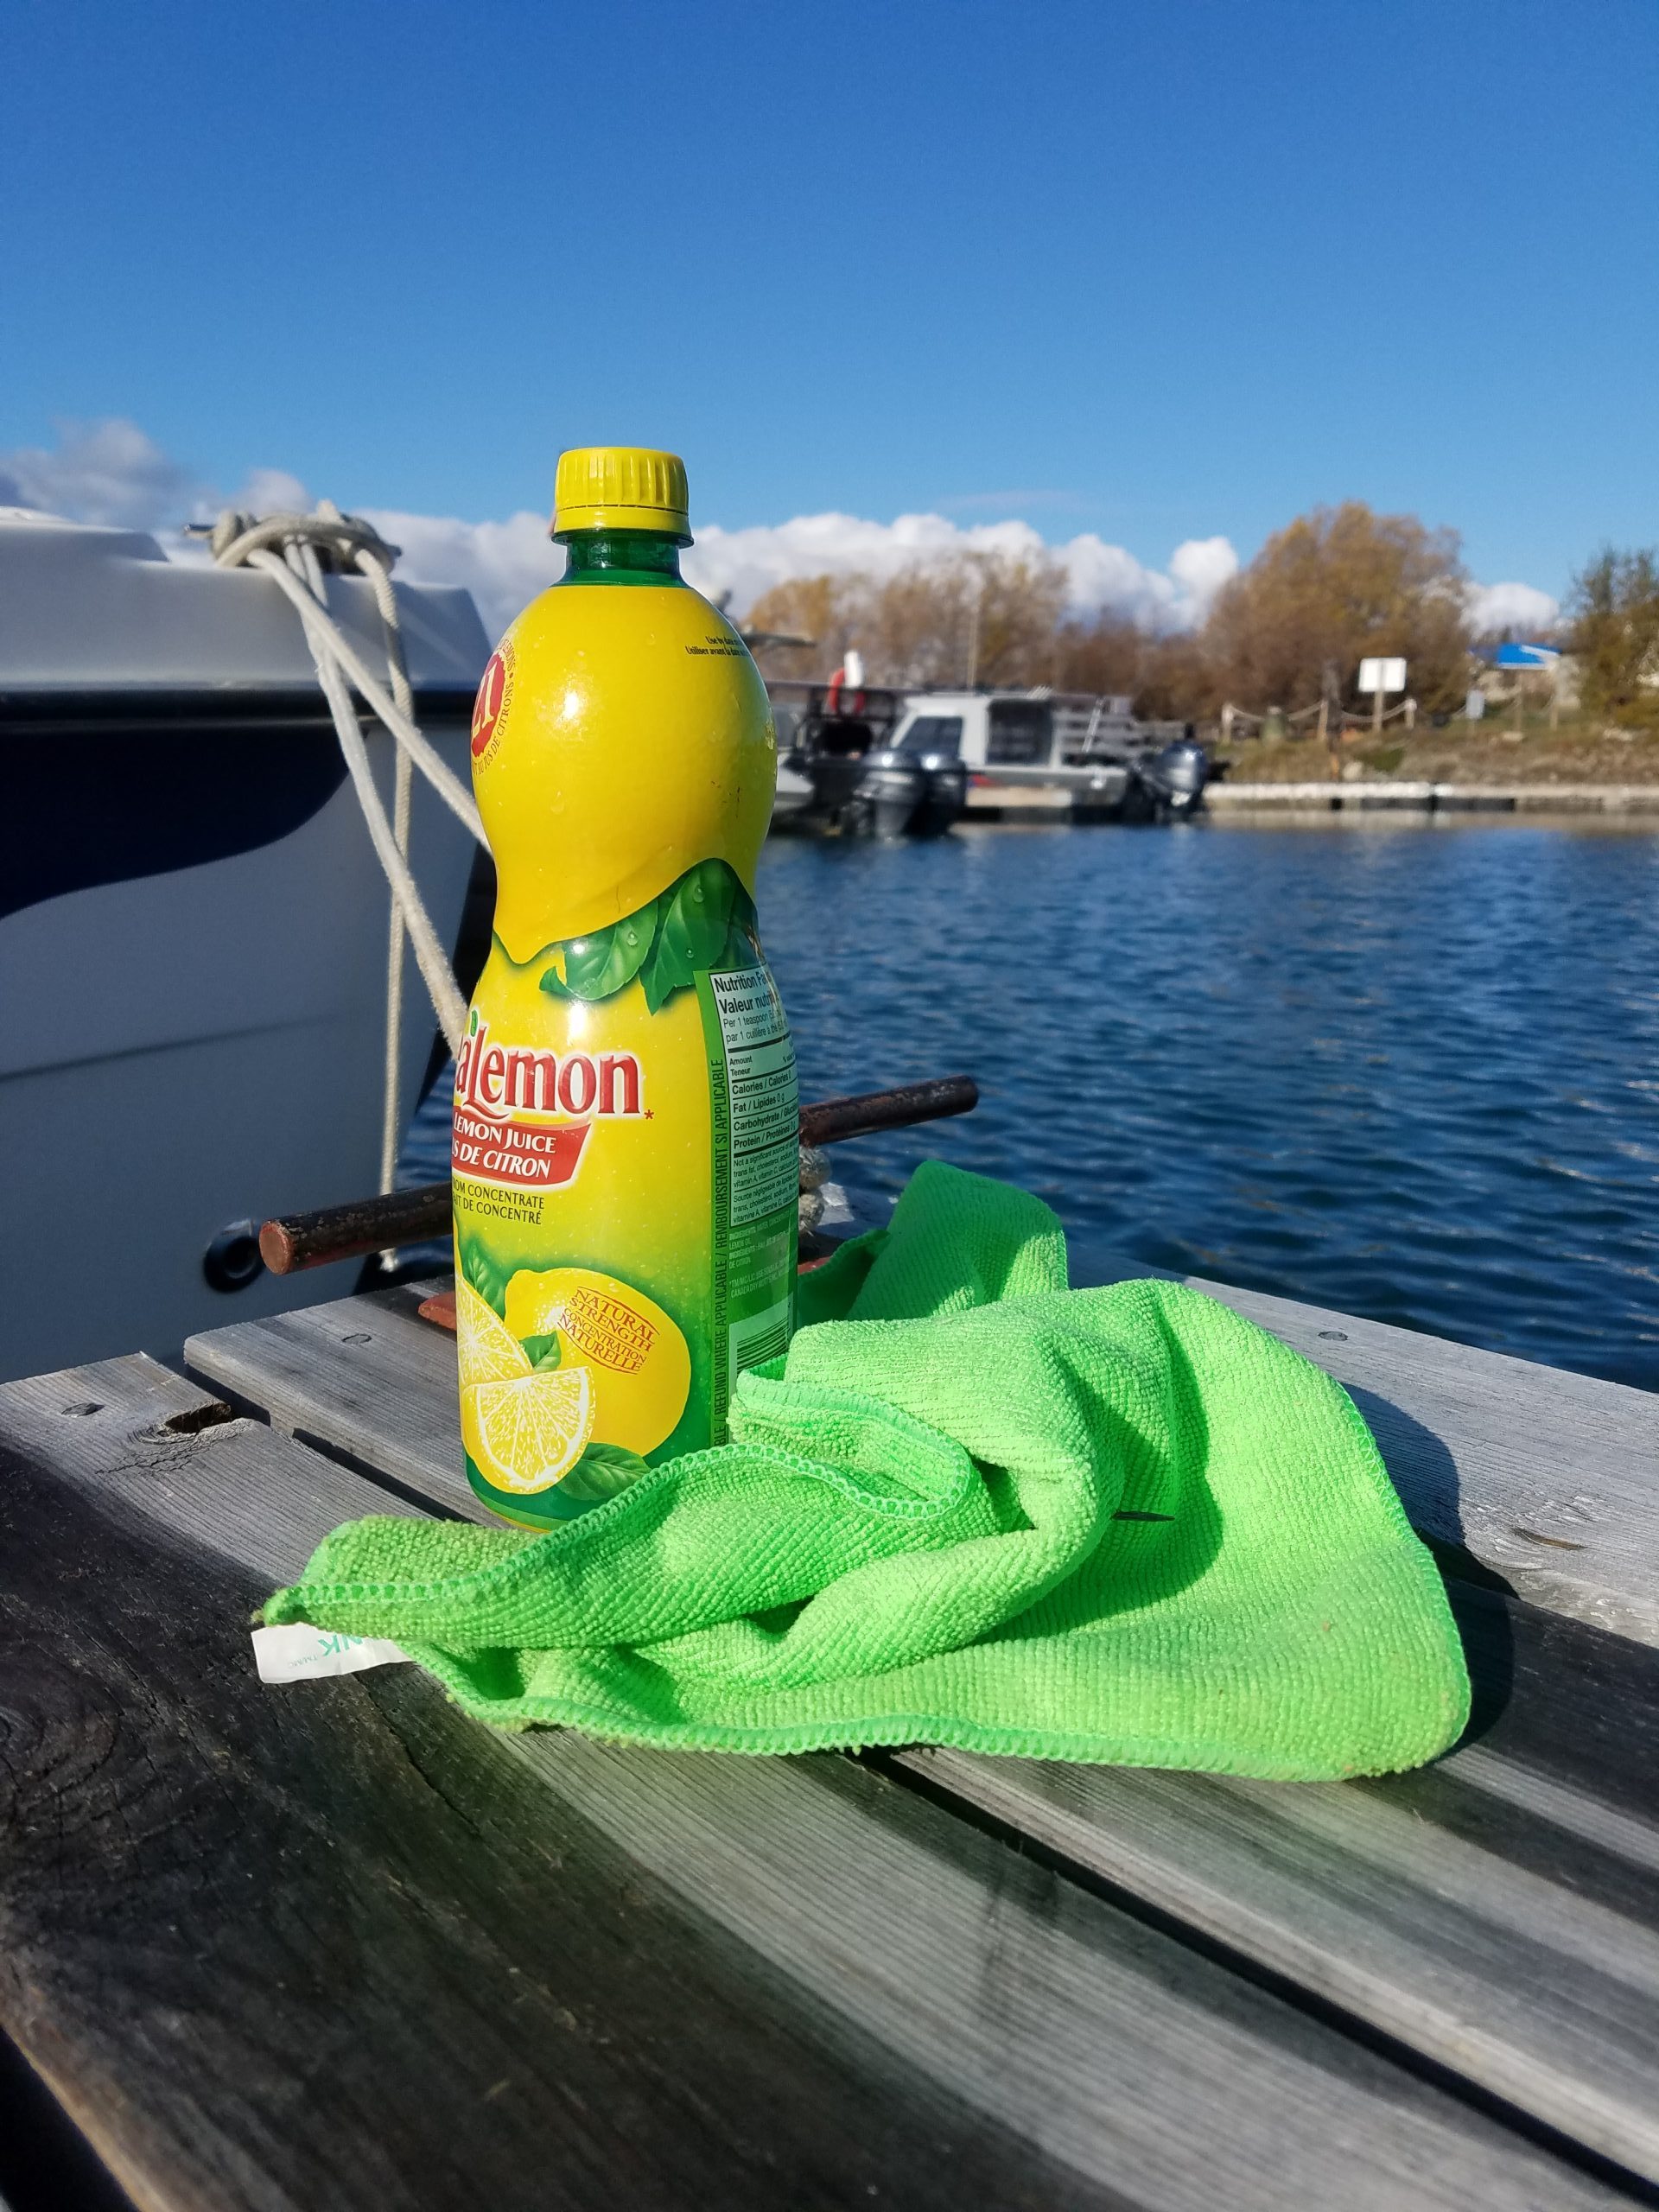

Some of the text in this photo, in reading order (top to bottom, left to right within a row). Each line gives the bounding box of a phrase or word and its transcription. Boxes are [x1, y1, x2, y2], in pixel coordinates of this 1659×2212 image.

[491, 736, 501, 755] DE
[497, 682, 514, 736] CITRONS
[714, 974, 758, 993] Nutrition
[719, 997, 753, 1014] Valeur
[723, 1019, 736, 1028] Per
[738, 1017, 742, 1026] 1
[726, 1034, 738, 1045] par
[740, 1032, 744, 1040] 1
[729, 1055, 753, 1065] Amount
[730, 1068, 751, 1077] Teneur
[710, 1058, 728, 1129] APPLICABLE
[732, 1082, 763, 1095] Calories
[733, 1103, 747, 1113] Fat
[753, 1096, 776, 1109] Lipides
[454, 1112, 557, 1154] LEMON JUICE
[715, 1129, 728, 1145] SI
[734, 1114, 780, 1131] Carbohydrate
[734, 1135, 761, 1149] Protein
[460, 1141, 483, 1166] DE
[483, 1150, 551, 1179] CITRON
[453, 1177, 545, 1210] ROM CONCENTRATE
[715, 1148, 728, 1249] REMBOURSEMENT
[463, 1198, 474, 1211] DE
[476, 1202, 542, 1225] CONCENTRÉ
[715, 1260, 728, 1326] APPLICABLE
[569, 1297, 652, 1352] STRENGTH
[574, 1289, 654, 1341] NATURAL
[560, 1313, 643, 1371] NATURELLE
[563, 1307, 647, 1364] CONCENTRATION
[715, 1328, 727, 1370] WHERE
[715, 1371, 727, 1416] REFUND
[715, 1423, 727, 1447] BLE
